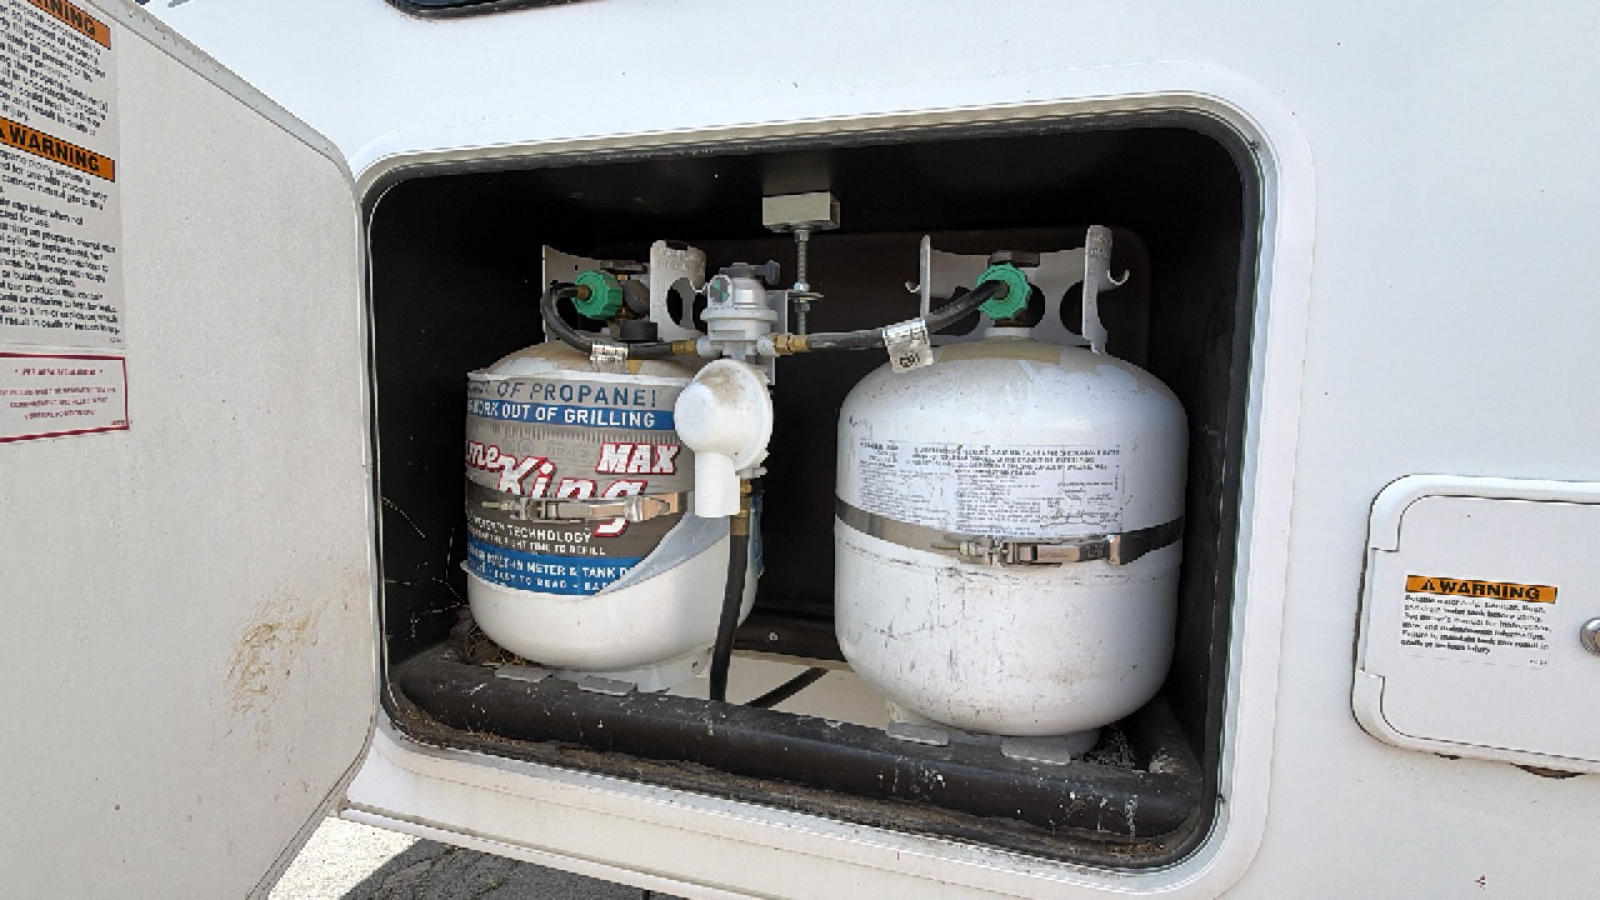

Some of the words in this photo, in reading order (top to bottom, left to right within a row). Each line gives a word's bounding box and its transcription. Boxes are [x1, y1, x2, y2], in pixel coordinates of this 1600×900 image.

[31, 67, 63, 92] propane
[20, 85, 42, 103] could
[24, 74, 73, 106] uncontrolled
[9, 124, 100, 173] WARNING
[13, 164, 22, 175] for
[29, 159, 53, 175] piping
[2, 173, 34, 191] connect
[50, 209, 70, 222] when
[7, 235, 39, 249] cylinder
[13, 248, 38, 261] piping
[41, 254, 55, 262] and
[5, 316, 29, 325] result
[497, 380, 524, 398] OF
[529, 381, 657, 408] PROPANE!
[502, 403, 531, 420] OUT
[535, 406, 559, 421] OF
[564, 408, 656, 428] GRILLING
[595, 442, 680, 475] MAX
[507, 524, 591, 544] TECHNOLOGY
[529, 541, 550, 552] TIME
[554, 544, 566, 554] TO
[569, 545, 606, 556] REFILL
[486, 552, 524, 571] BUILT-IN
[526, 560, 566, 576] METER
[582, 566, 616, 578] TANK
[519, 575, 531, 585] TO
[536, 578, 567, 589] READ
[1439, 580, 1541, 600] WARNING
